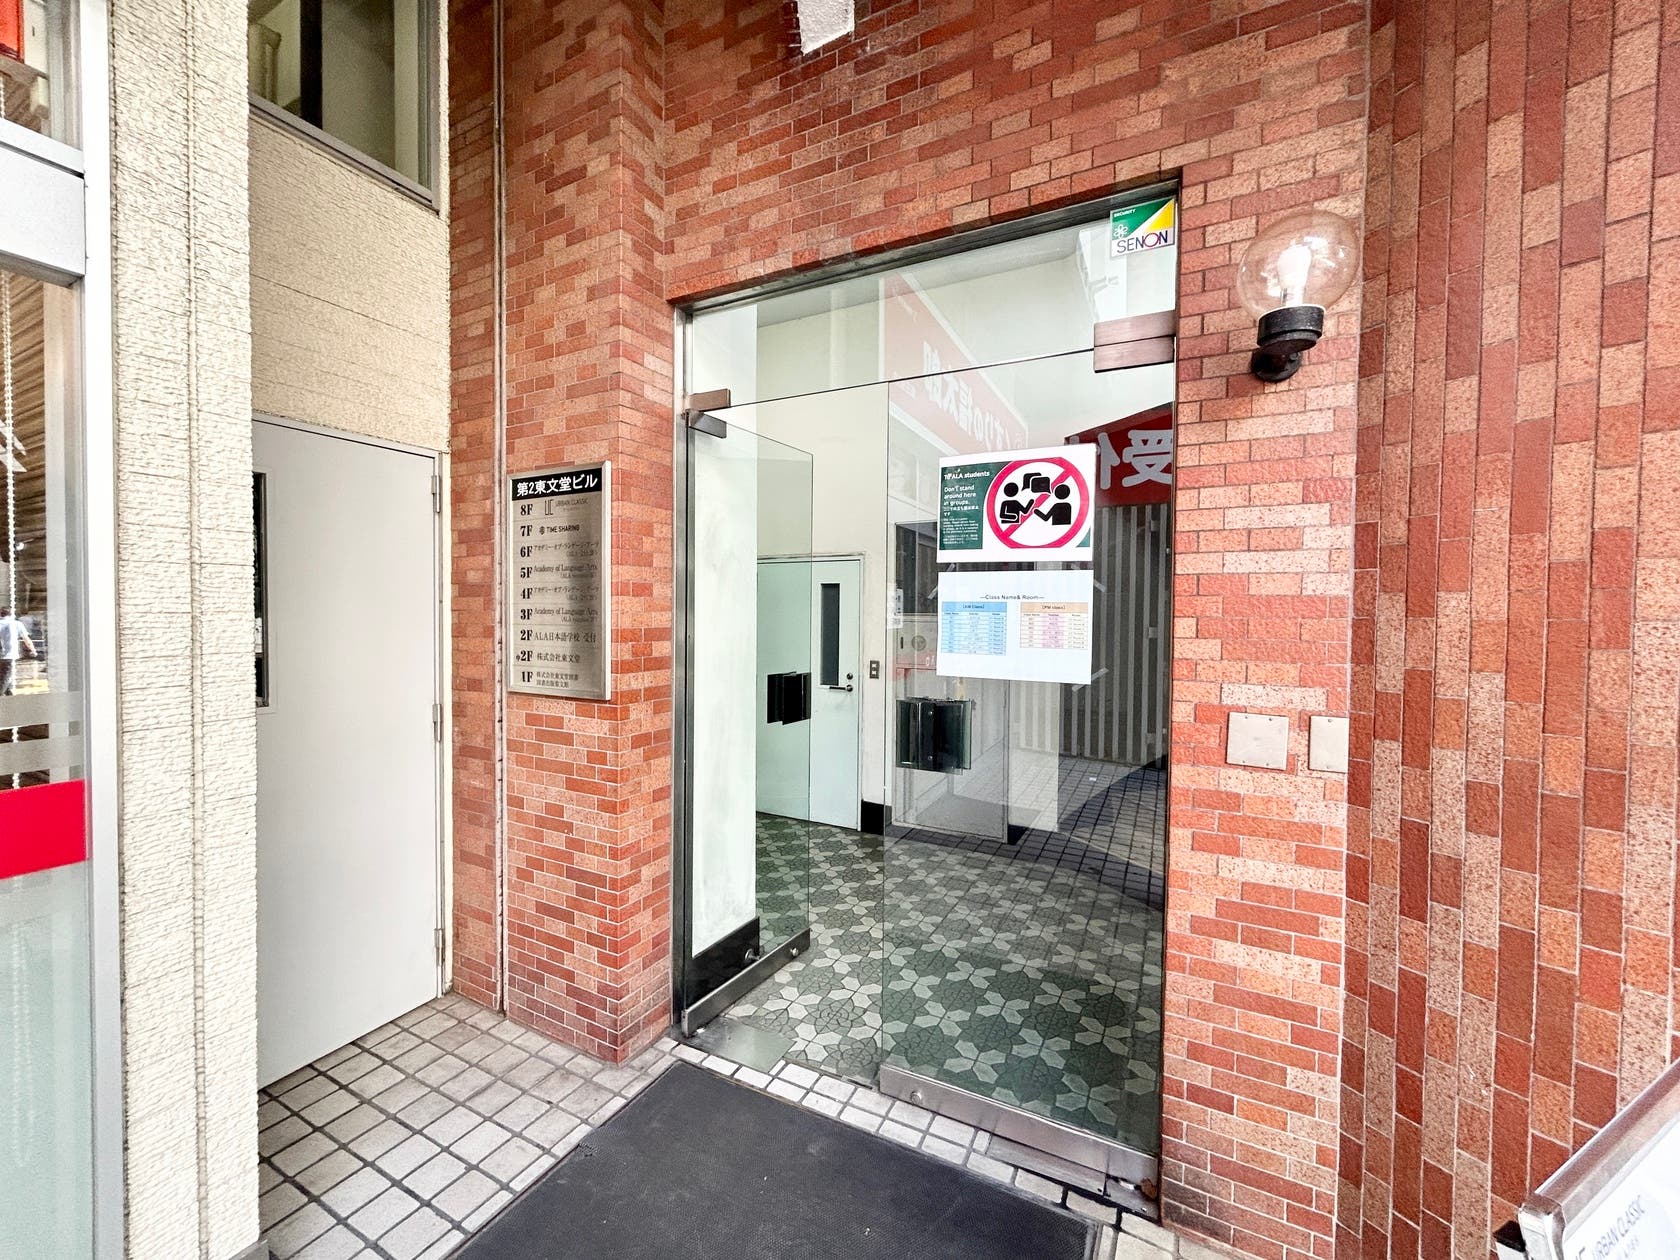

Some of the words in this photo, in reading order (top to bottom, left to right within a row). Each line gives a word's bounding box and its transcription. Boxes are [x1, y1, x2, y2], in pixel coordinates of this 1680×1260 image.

[1117, 230, 1168, 254] SENON
[517, 474, 598, 497] 第2東文堂ビル
[520, 504, 533, 516] 8F
[520, 525, 533, 536] 7F
[520, 546, 533, 558] 6F
[520, 567, 533, 578] 5F
[520, 588, 533, 599] 4F
[520, 608, 533, 620] 3F
[520, 629, 533, 640] 2F
[522, 671, 533, 682] 1F
